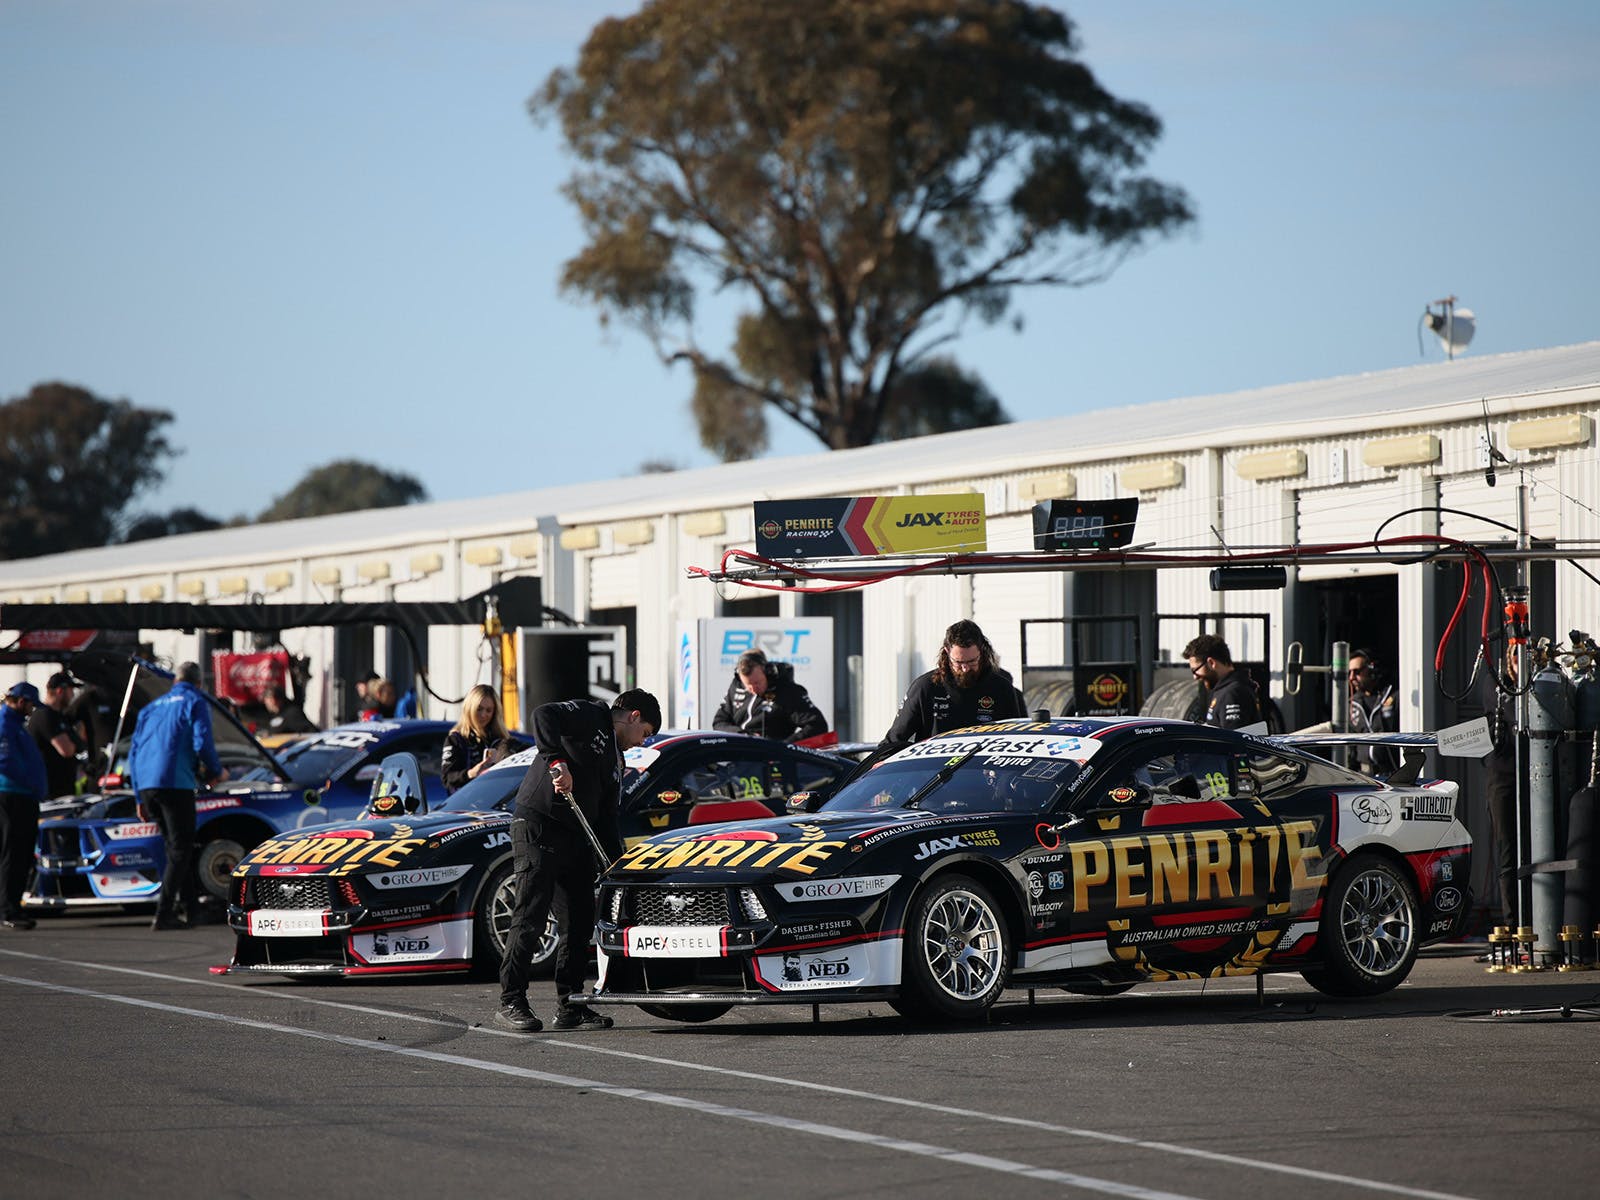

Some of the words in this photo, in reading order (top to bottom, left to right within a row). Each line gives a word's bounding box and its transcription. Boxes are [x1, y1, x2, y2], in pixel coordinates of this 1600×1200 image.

[896, 512, 945, 527] JAX
[946, 511, 980, 519] TYRES
[951, 518, 980, 526] AUTO
[785, 518, 834, 530] PENRITE
[721, 630, 811, 654] BRT
[1087, 683, 1129, 695] PENRITE
[899, 737, 1045, 758] Steadfast
[983, 755, 1034, 767] Payne
[740, 776, 764, 799] 26
[1205, 772, 1229, 798] 19
[1400, 796, 1453, 820] SOUTHCOTT
[441, 823, 486, 844] AUSTRALIAN
[483, 832, 512, 849] JA
[864, 825, 914, 847] AUSTRALIAN
[913, 820, 942, 829] OWNED
[961, 830, 997, 841] TYRES
[914, 835, 969, 860] JAX
[974, 838, 1001, 847] AUTO
[250, 838, 427, 868] PENRITE
[603, 841, 847, 875] PENRITE
[1027, 854, 1064, 865] DUNLOP
[1067, 820, 1329, 913] PENRITE
[391, 871, 440, 886] GROVE
[441, 868, 459, 877] HIRE
[1029, 880, 1044, 889] ACL
[805, 881, 864, 897] GROVE
[865, 878, 885, 889] HIRE
[371, 909, 400, 918] DASHER
[403, 904, 431, 913] FISHER
[1036, 902, 1064, 912] VELOCITY
[257, 919, 282, 931] APEX
[781, 925, 815, 935] DASHER
[820, 920, 852, 930] FISHER
[1121, 928, 1181, 943] AUSTRALIAN
[1182, 925, 1215, 937] OWNED
[1216, 922, 1245, 933] SINCE
[636, 934, 670, 952] APEX
[672, 937, 712, 948] STEEL
[794, 931, 829, 941] Tasmanian
[394, 940, 430, 952] NED
[808, 962, 850, 976] NED
